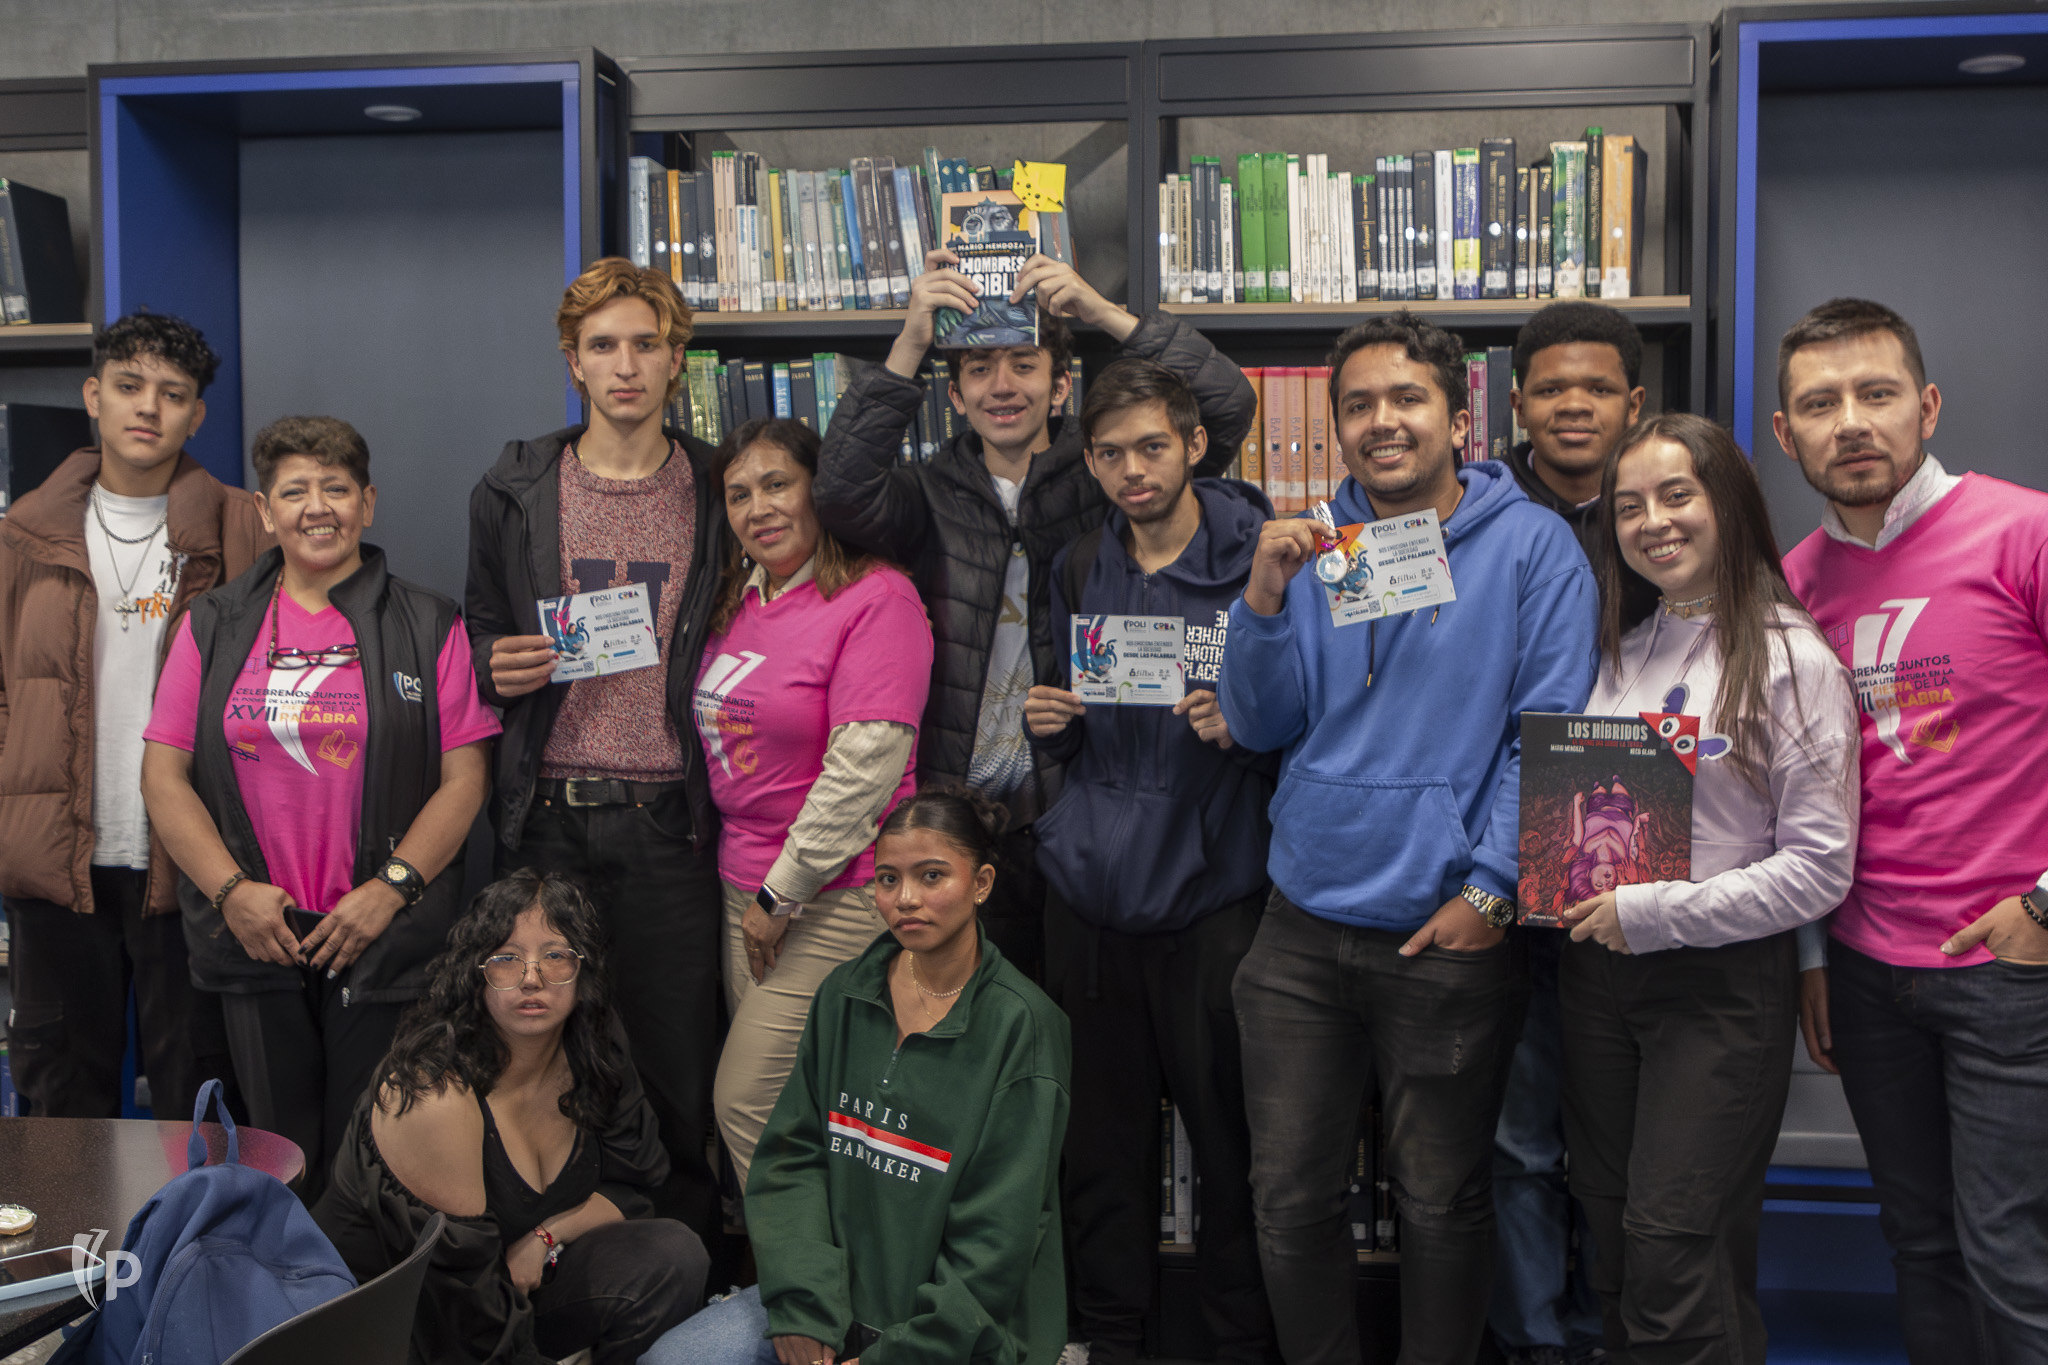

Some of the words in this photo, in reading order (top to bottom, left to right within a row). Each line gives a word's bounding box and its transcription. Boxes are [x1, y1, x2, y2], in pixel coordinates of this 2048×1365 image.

[957, 243, 984, 251] MARIO
[984, 242, 1024, 250] MENDOZA
[959, 255, 1026, 273] HOMBRES
[967, 272, 1018, 297] SIBL
[1377, 523, 1396, 533] POLI
[1407, 549, 1436, 560] PALABRAS
[1130, 620, 1146, 628] POLI
[1899, 655, 1951, 671] JUNTOS
[1879, 672, 1927, 685] LITERATURA
[1943, 668, 1955, 676] LA
[236, 687, 310, 697] CELEBREMOS
[312, 691, 360, 700] JUNTOS
[1873, 681, 1913, 696] FIESTA
[1914, 679, 1931, 690] DE
[1934, 676, 1951, 687] LA
[724, 695, 755, 708] JUNTOS
[1875, 688, 1955, 710] PALABRA
[227, 704, 278, 721] XVII
[280, 712, 358, 725] PALABRA
[1567, 721, 1590, 739] LOS
[1592, 719, 1649, 741] HÍBRIDOS
[1550, 743, 1564, 751] MARIO
[1564, 744, 1585, 753] MENDOZA
[839, 1092, 909, 1131] PARIS
